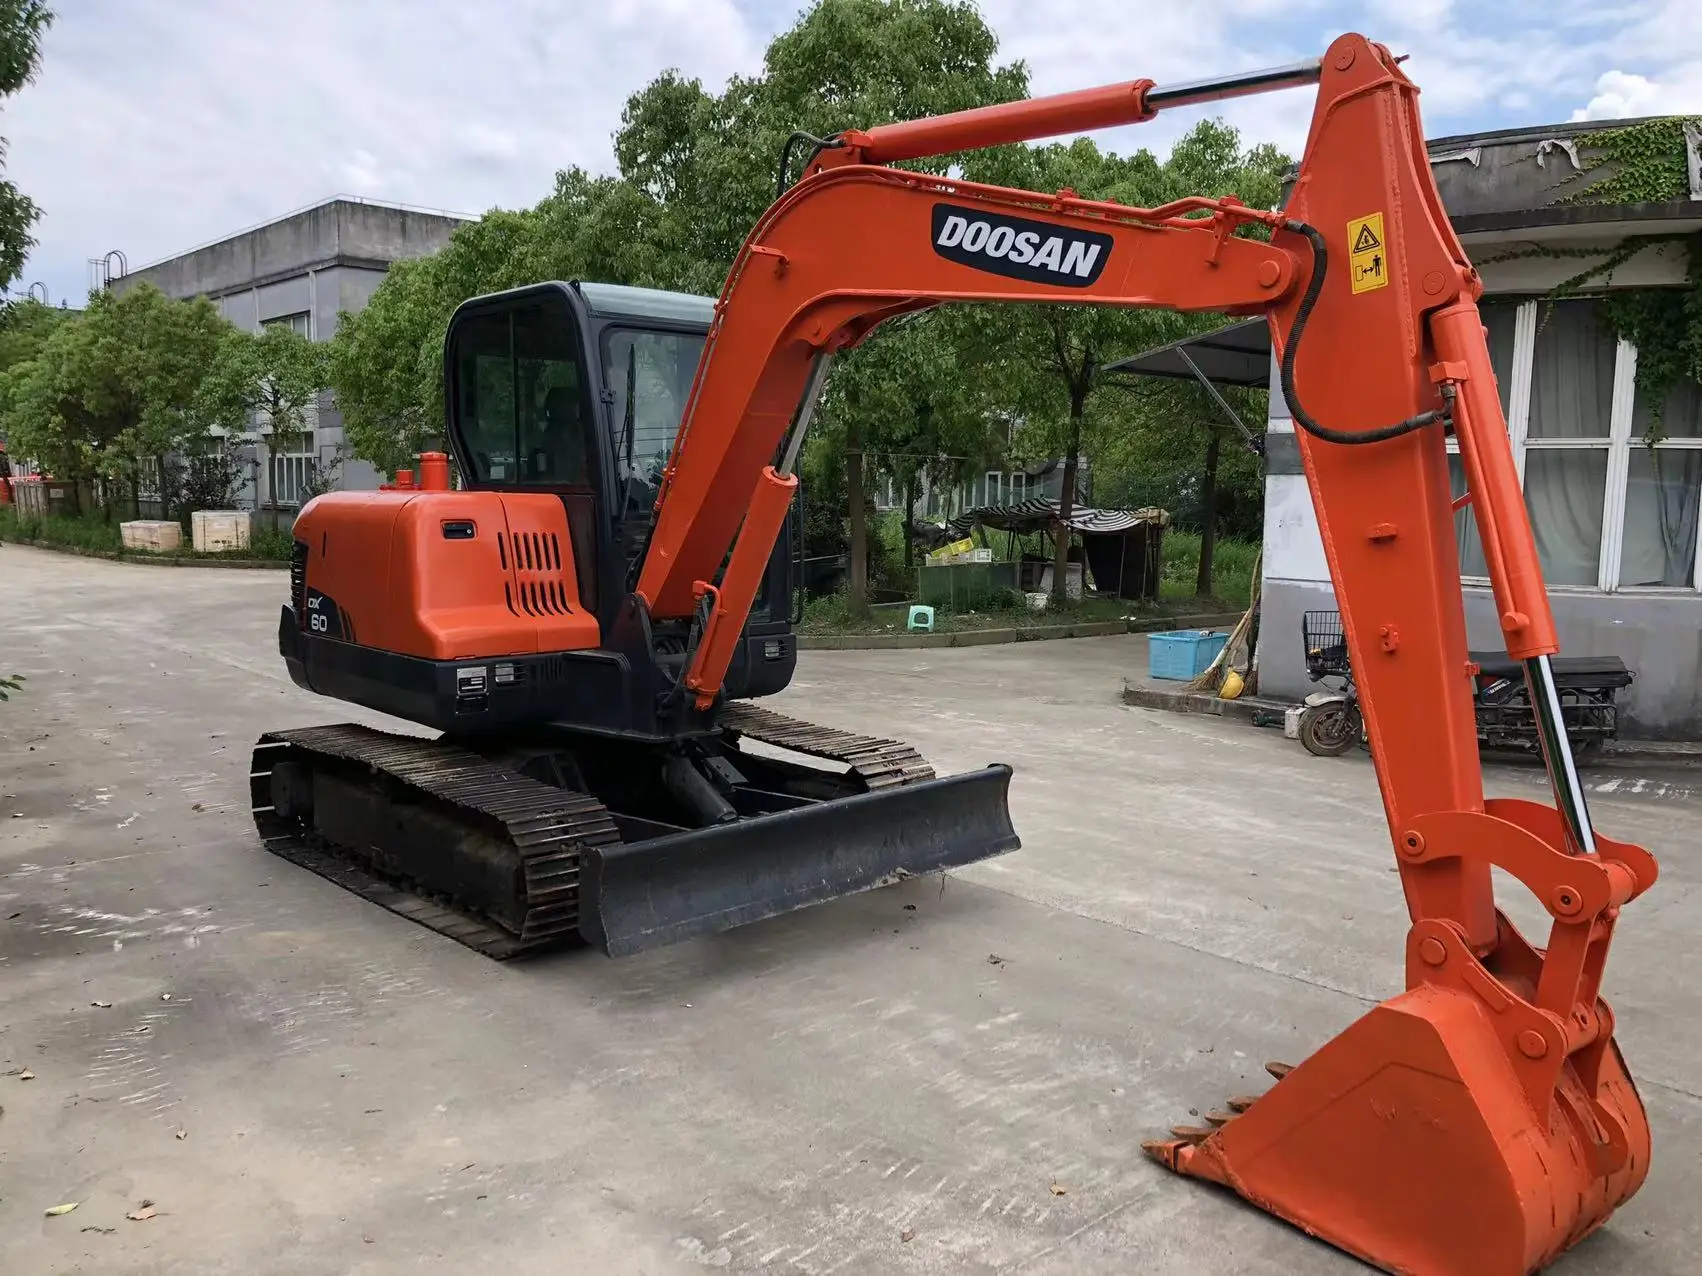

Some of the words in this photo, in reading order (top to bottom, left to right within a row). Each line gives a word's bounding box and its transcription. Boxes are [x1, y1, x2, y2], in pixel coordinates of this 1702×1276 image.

[937, 215, 1102, 278] DOOSAN
[308, 596, 323, 610] DX
[311, 613, 328, 632] 60
